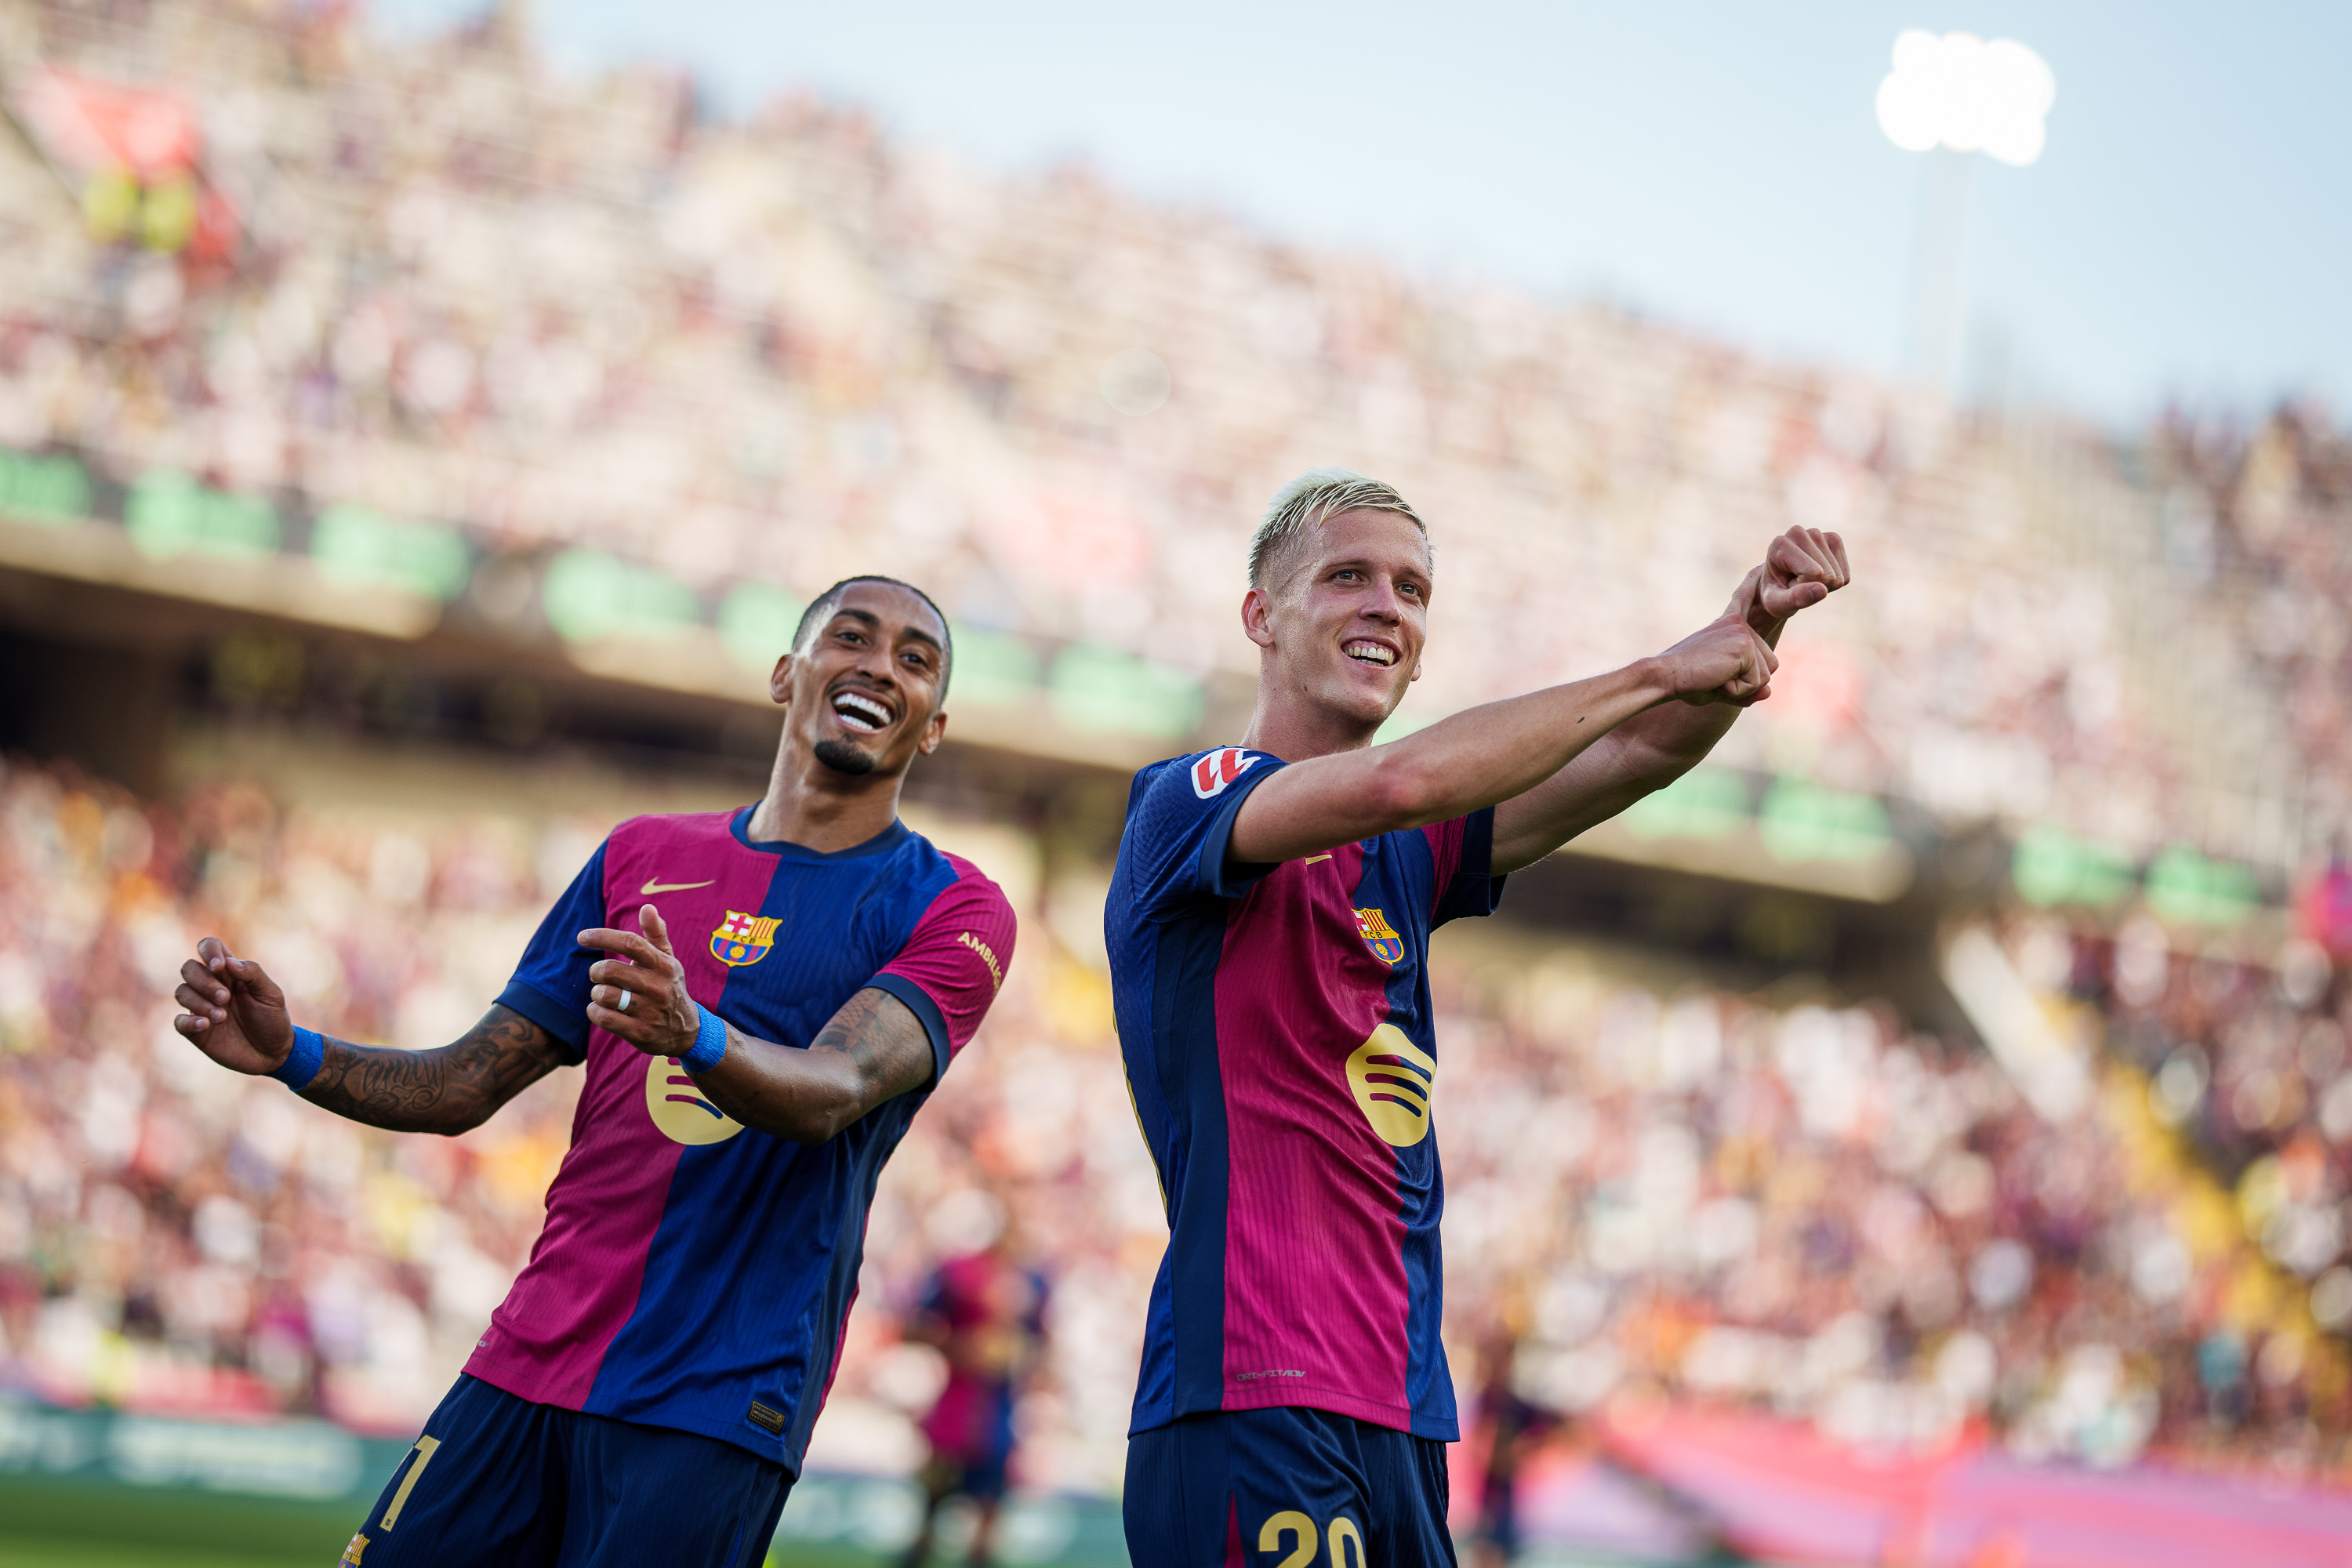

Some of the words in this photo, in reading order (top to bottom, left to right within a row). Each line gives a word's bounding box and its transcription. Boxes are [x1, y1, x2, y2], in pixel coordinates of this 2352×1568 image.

[732, 934, 757, 944] FCB
[957, 931, 1002, 989] AMBILIG
[1258, 1510, 1367, 1568] 20
